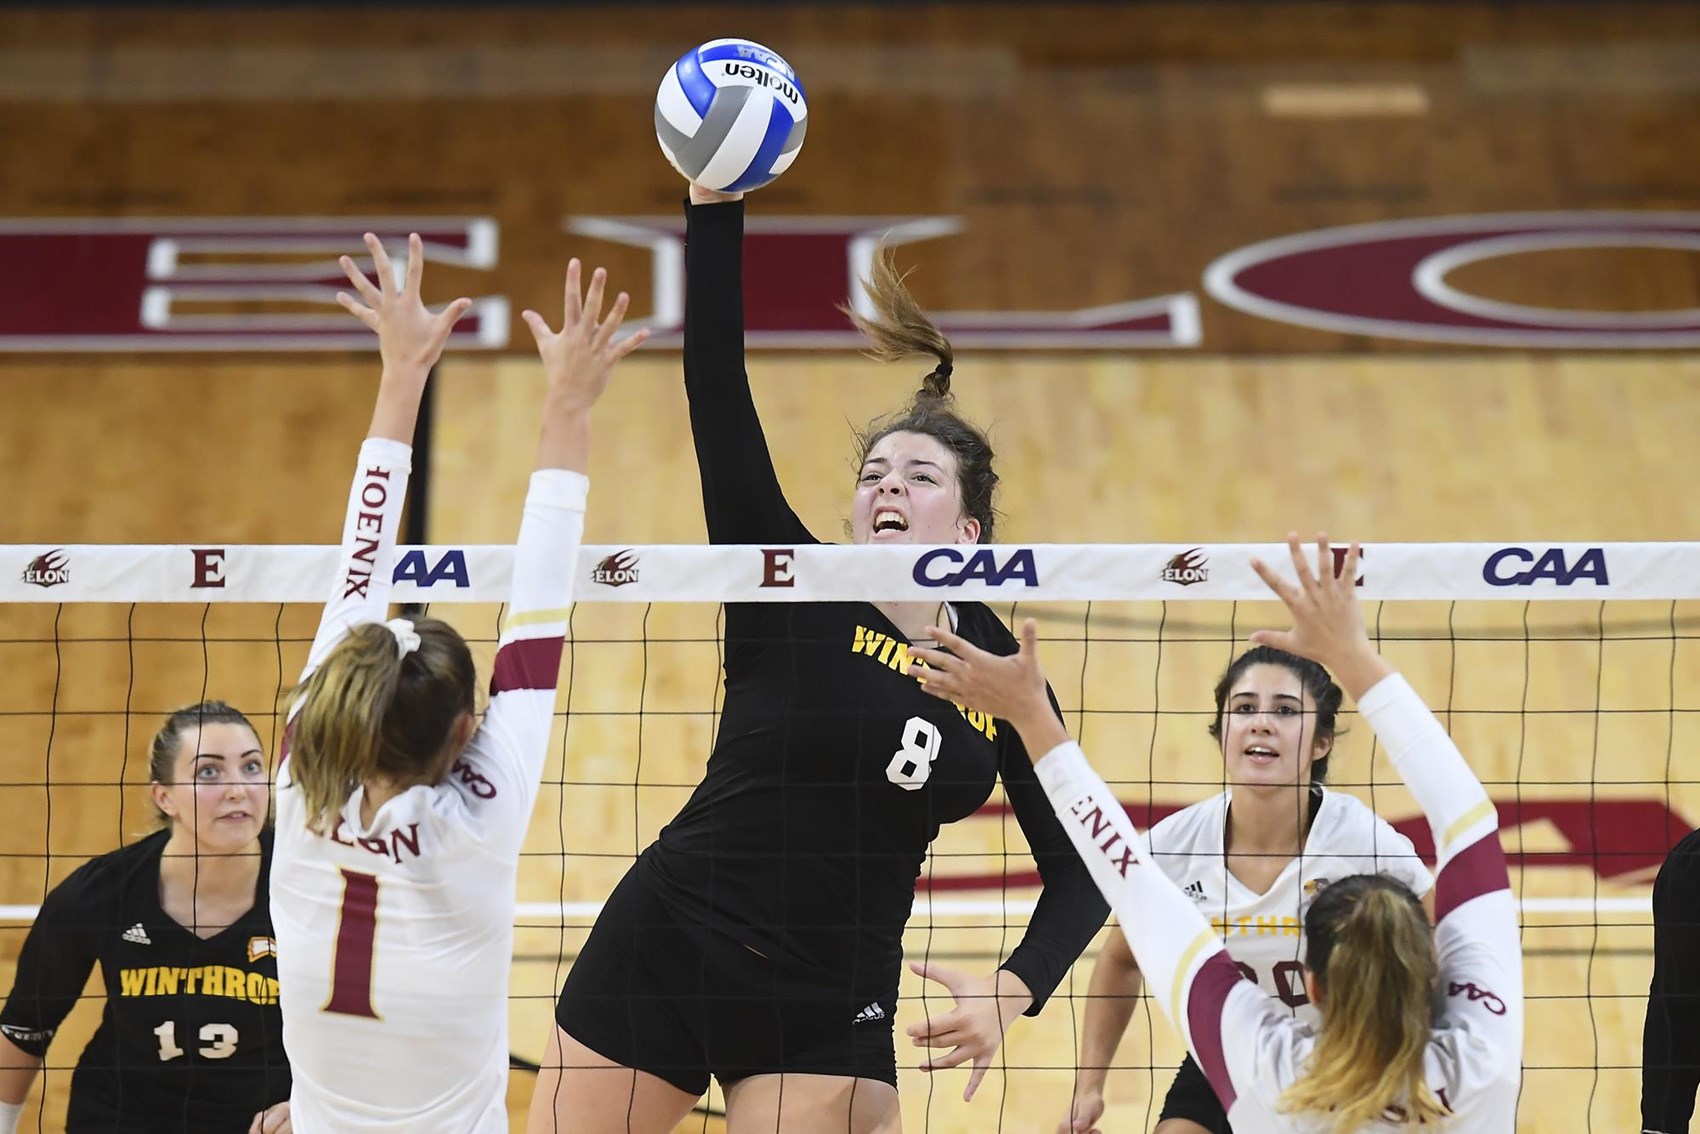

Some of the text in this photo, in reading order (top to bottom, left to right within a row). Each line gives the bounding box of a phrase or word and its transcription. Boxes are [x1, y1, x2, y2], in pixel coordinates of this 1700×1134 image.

[725, 63, 798, 104] molten
[24, 569, 70, 583] ELON
[191, 549, 226, 588] E
[392, 550, 470, 588] AA
[593, 569, 640, 583] ELON
[759, 549, 795, 588] E
[912, 548, 1039, 588] CAA
[1162, 568, 1209, 582] ELON
[1482, 547, 1610, 587] CAA
[885, 716, 942, 791] 8
[319, 866, 384, 1020] 1
[153, 1020, 239, 1062] 13
